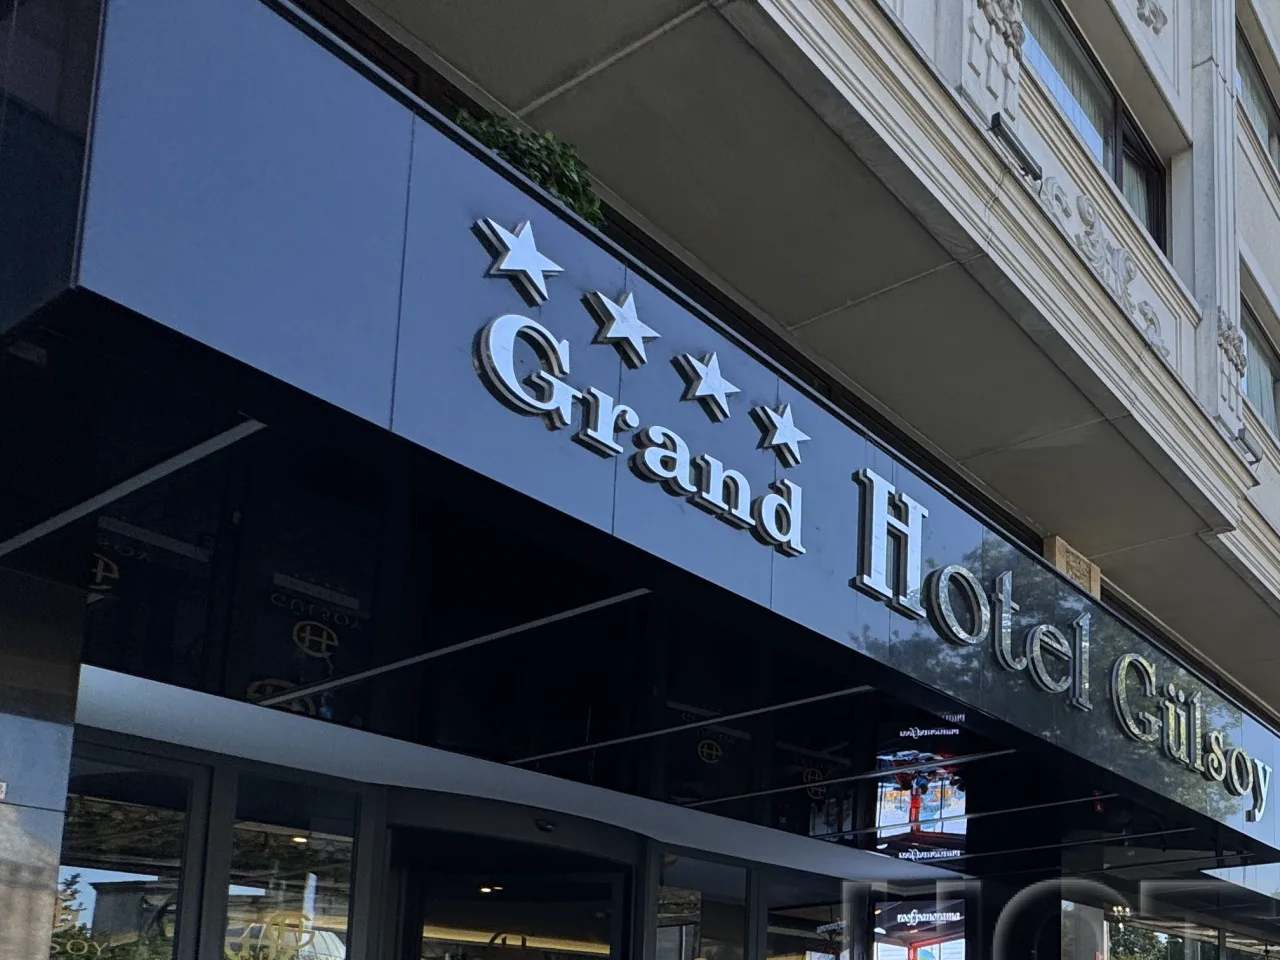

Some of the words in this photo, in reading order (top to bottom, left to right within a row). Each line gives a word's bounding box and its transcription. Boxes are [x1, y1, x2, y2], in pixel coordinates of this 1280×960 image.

[473, 314, 806, 558] Grand
[849, 468, 1094, 714] Hotel
[1111, 653, 1273, 823] Gülsoy
